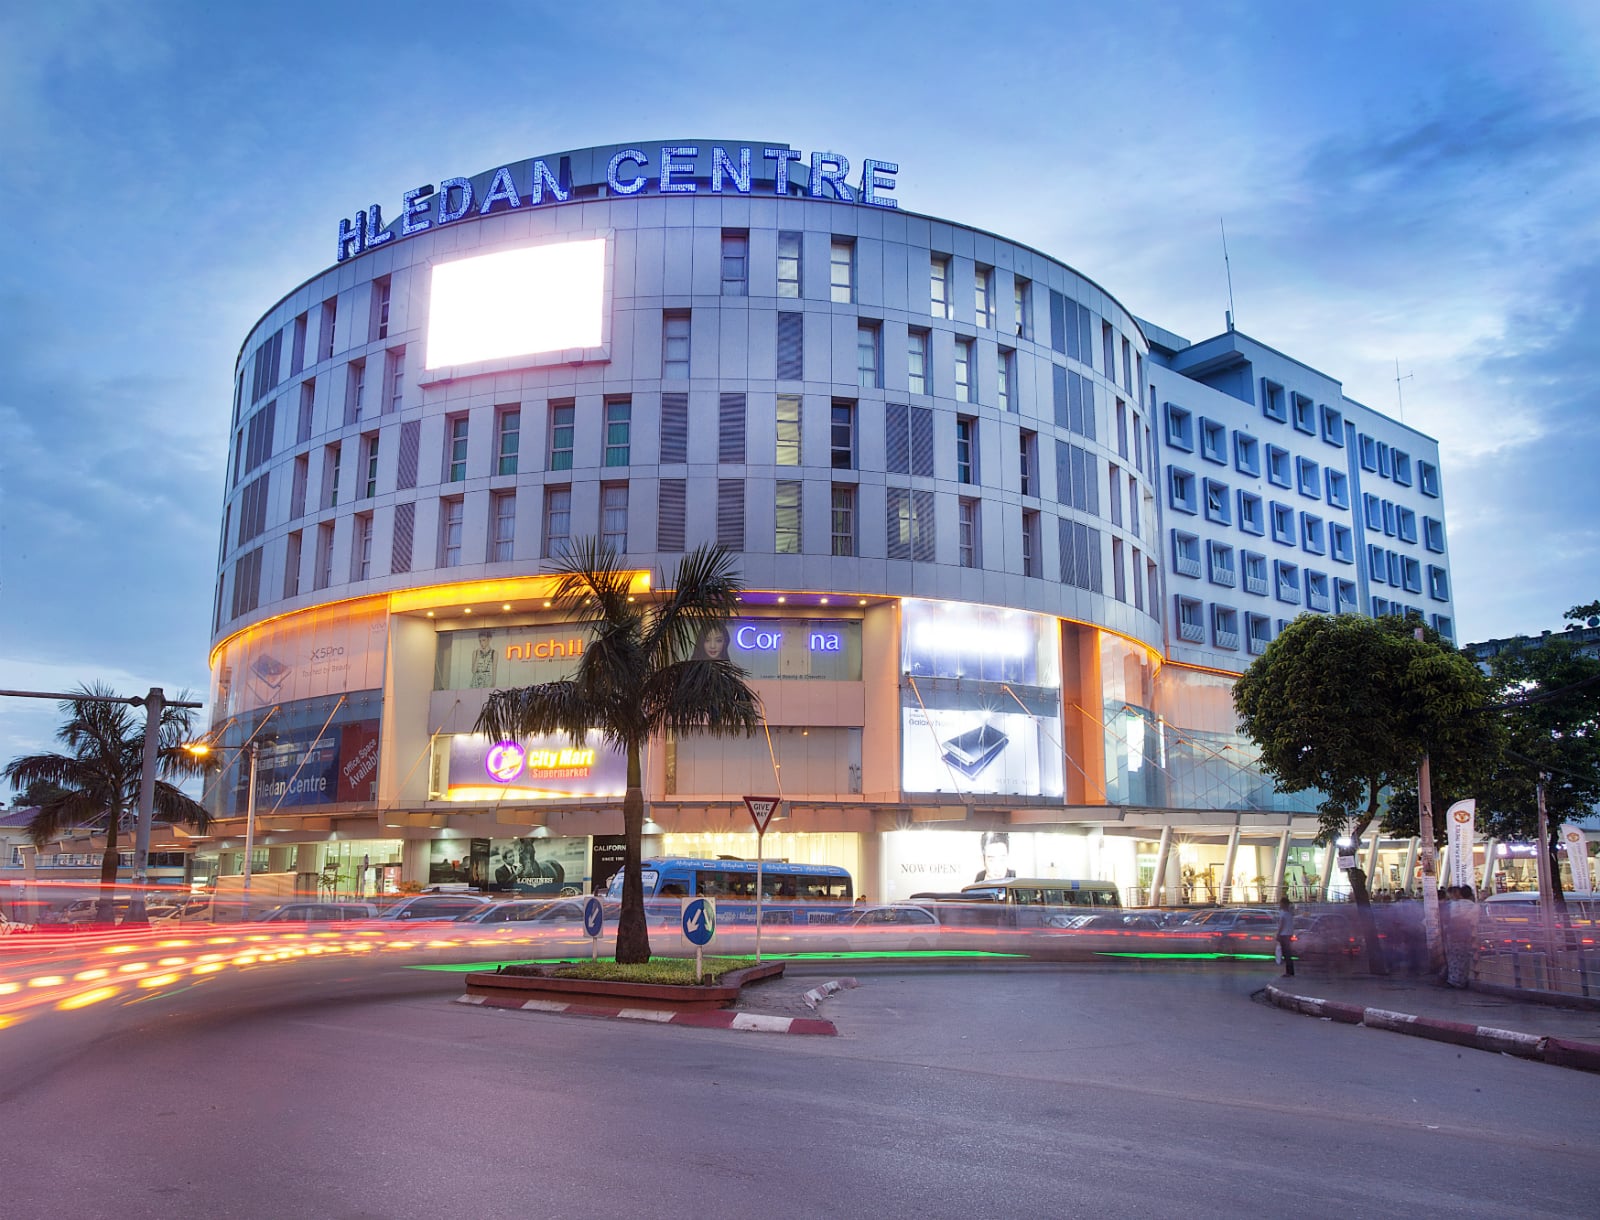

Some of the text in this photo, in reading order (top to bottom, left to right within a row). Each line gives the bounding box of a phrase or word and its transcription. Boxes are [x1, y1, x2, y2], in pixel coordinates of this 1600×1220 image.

[338, 146, 899, 261] HLEDAN CENTRE
[343, 739, 377, 776] Office Space
[528, 748, 594, 768] City Mart
[348, 751, 379, 789] Availabl
[532, 767, 588, 778] Supermarket
[256, 775, 327, 797] Hledan Centre
[754, 803, 769, 811] GIVE
[594, 844, 627, 852] CALIFORN
[900, 863, 926, 874] NOW
